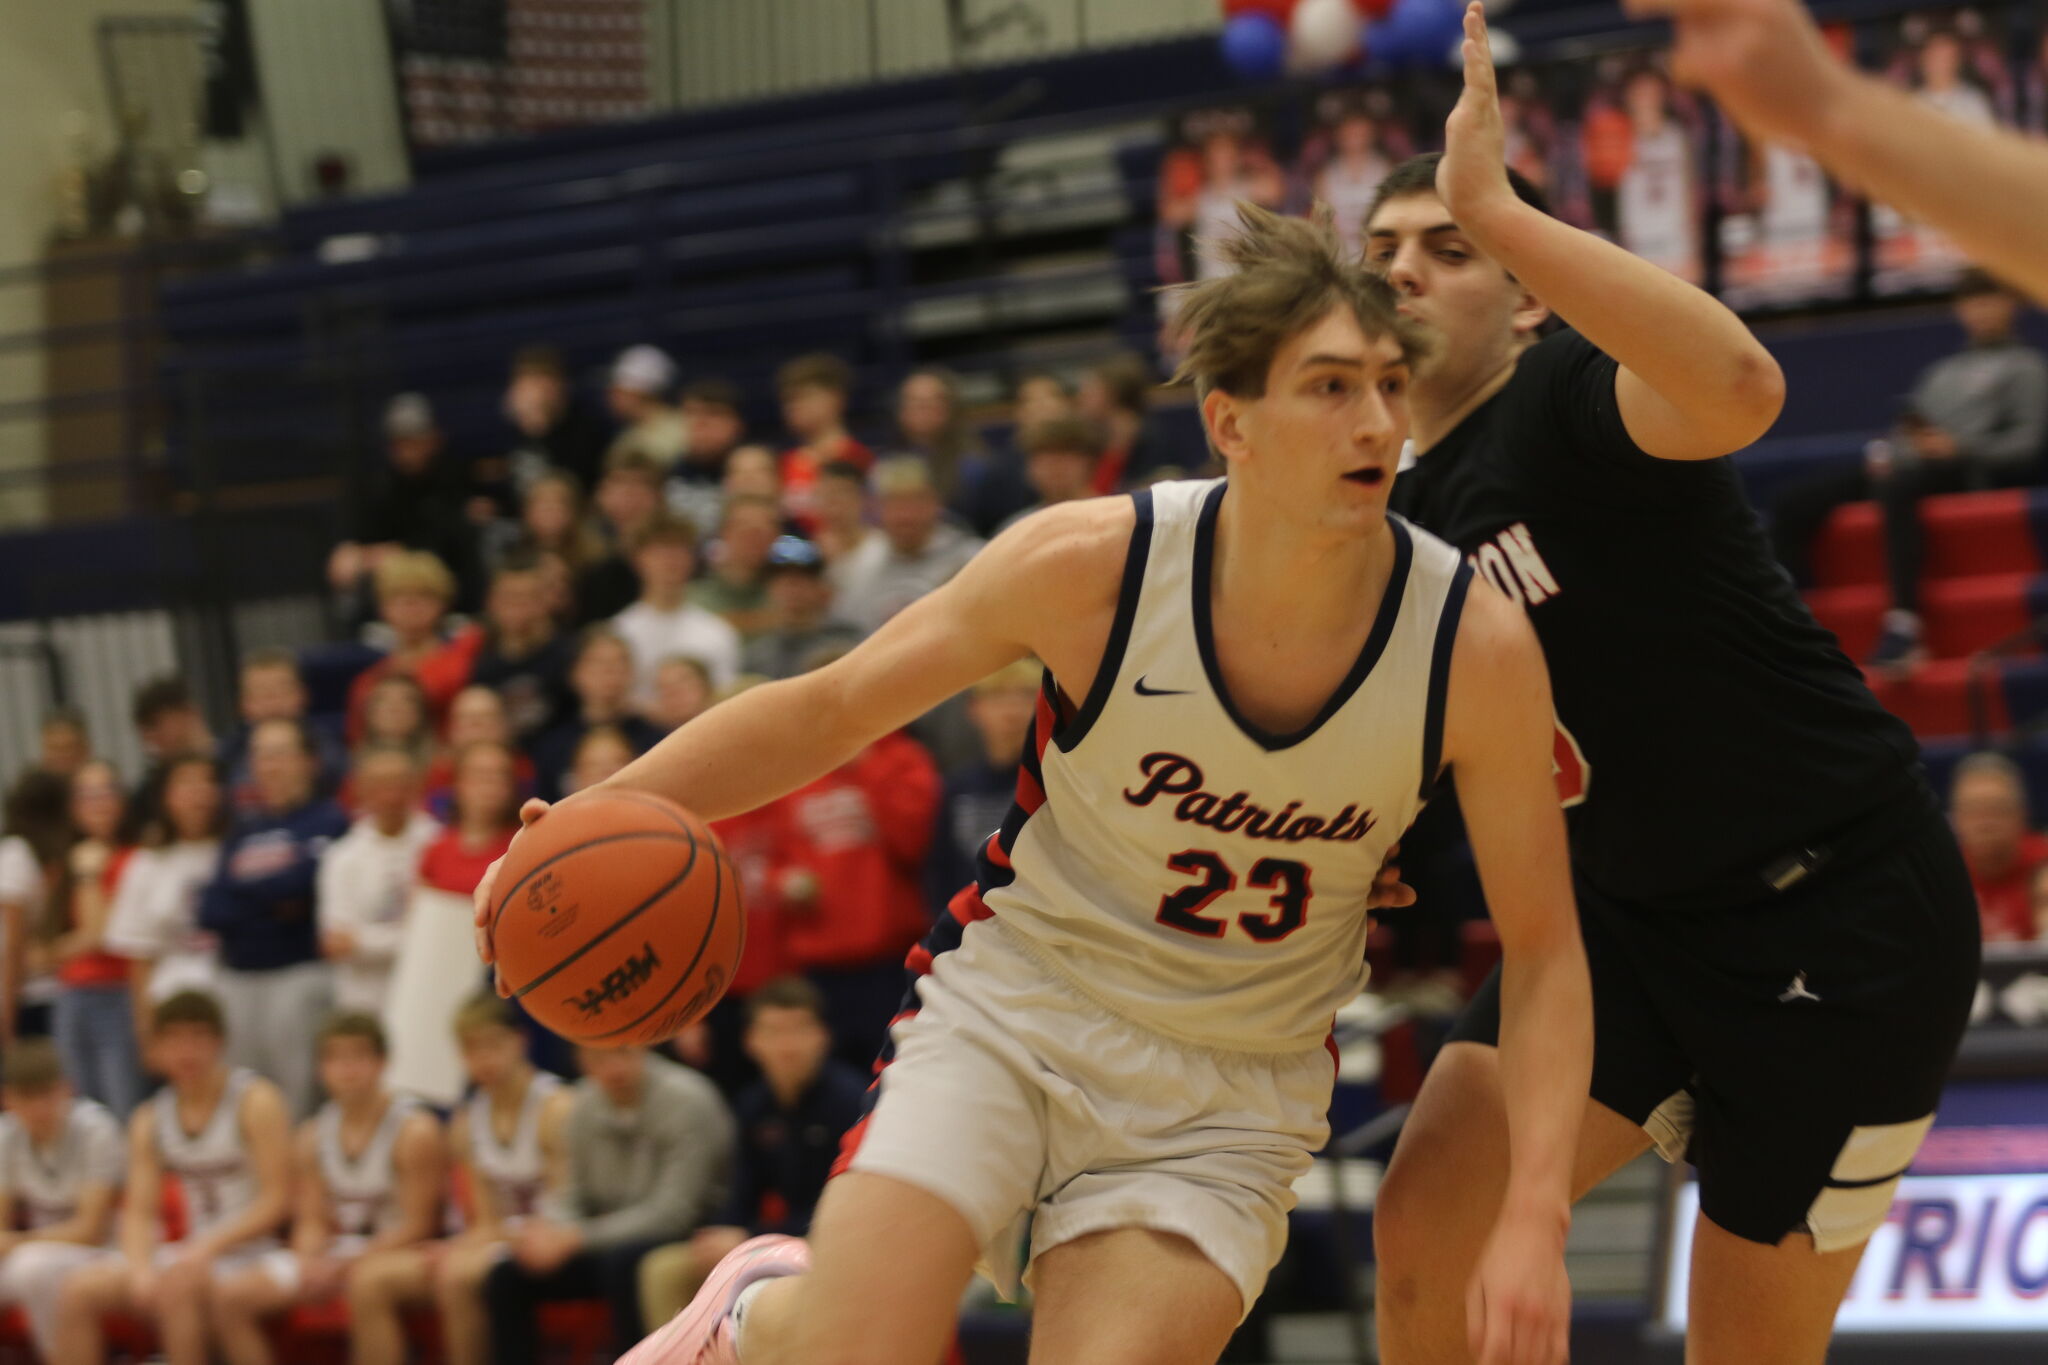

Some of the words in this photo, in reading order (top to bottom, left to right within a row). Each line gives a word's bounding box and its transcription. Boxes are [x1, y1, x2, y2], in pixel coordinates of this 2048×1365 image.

[1466, 521, 1562, 606] ON
[1122, 751, 1377, 844] Patriots
[1154, 848, 1314, 944] 23
[1850, 1196, 2048, 1302] RIO
